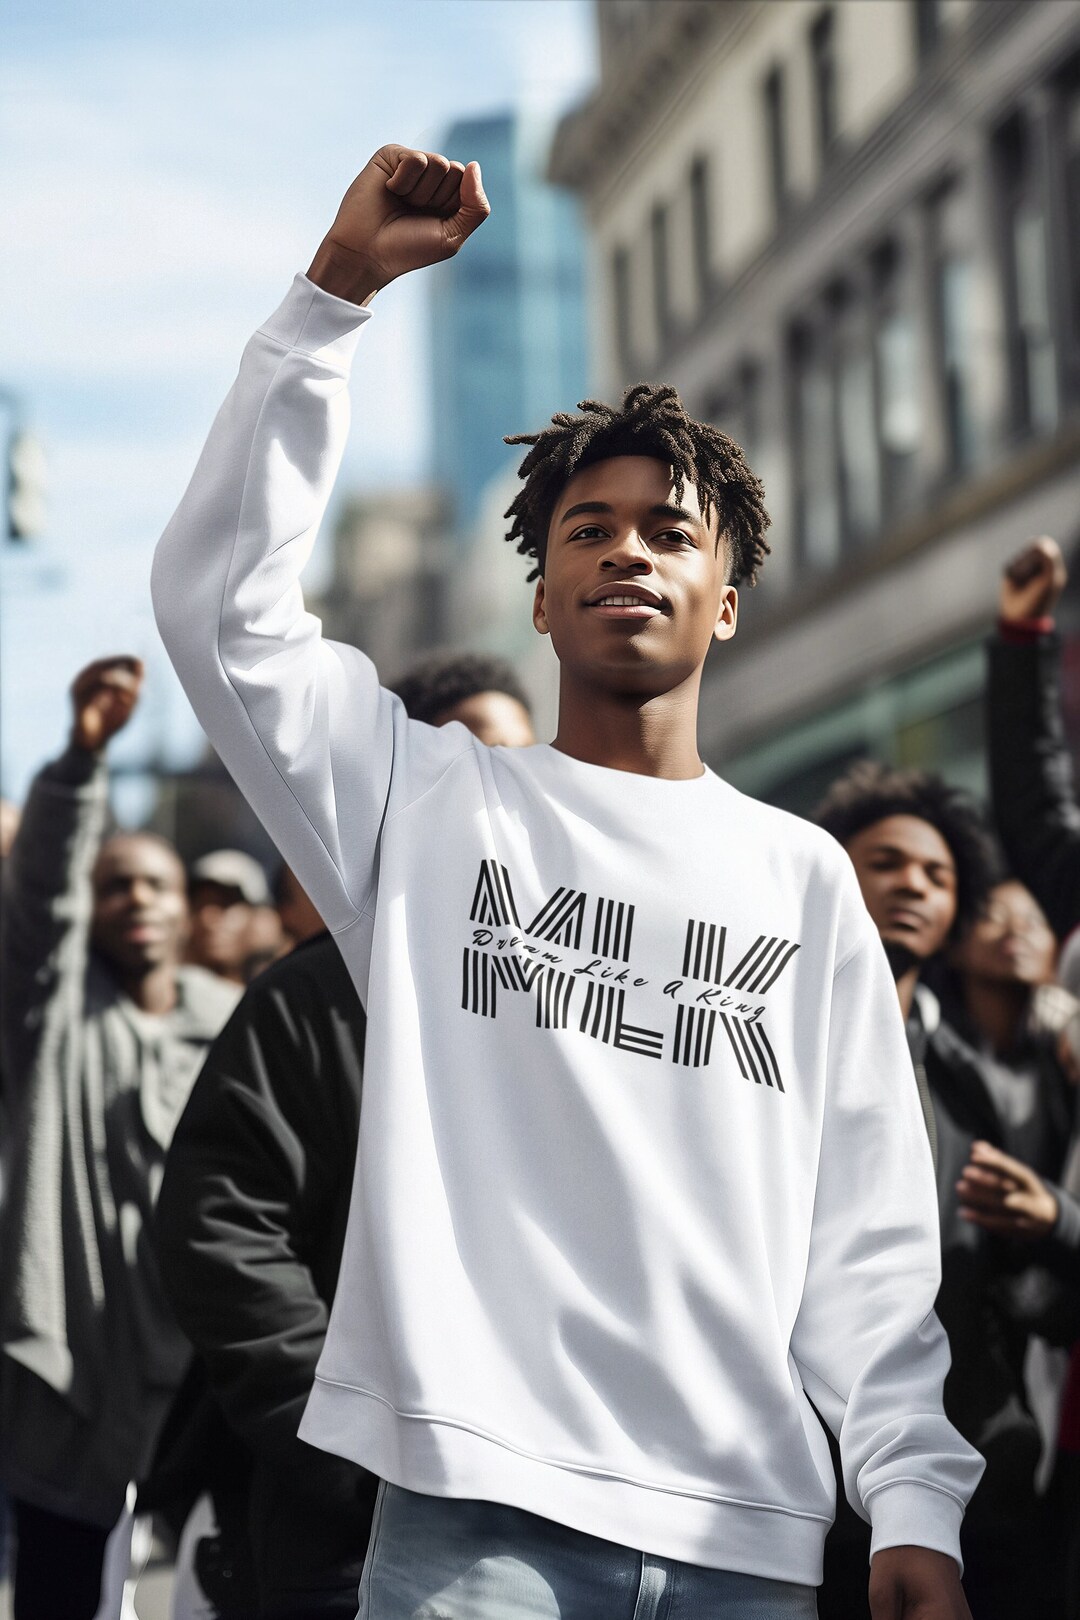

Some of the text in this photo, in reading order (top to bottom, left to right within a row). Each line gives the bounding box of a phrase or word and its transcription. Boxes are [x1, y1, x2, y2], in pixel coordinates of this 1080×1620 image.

[461, 859, 801, 1094] MLK
[472, 929, 766, 1024] Dream Like A King
